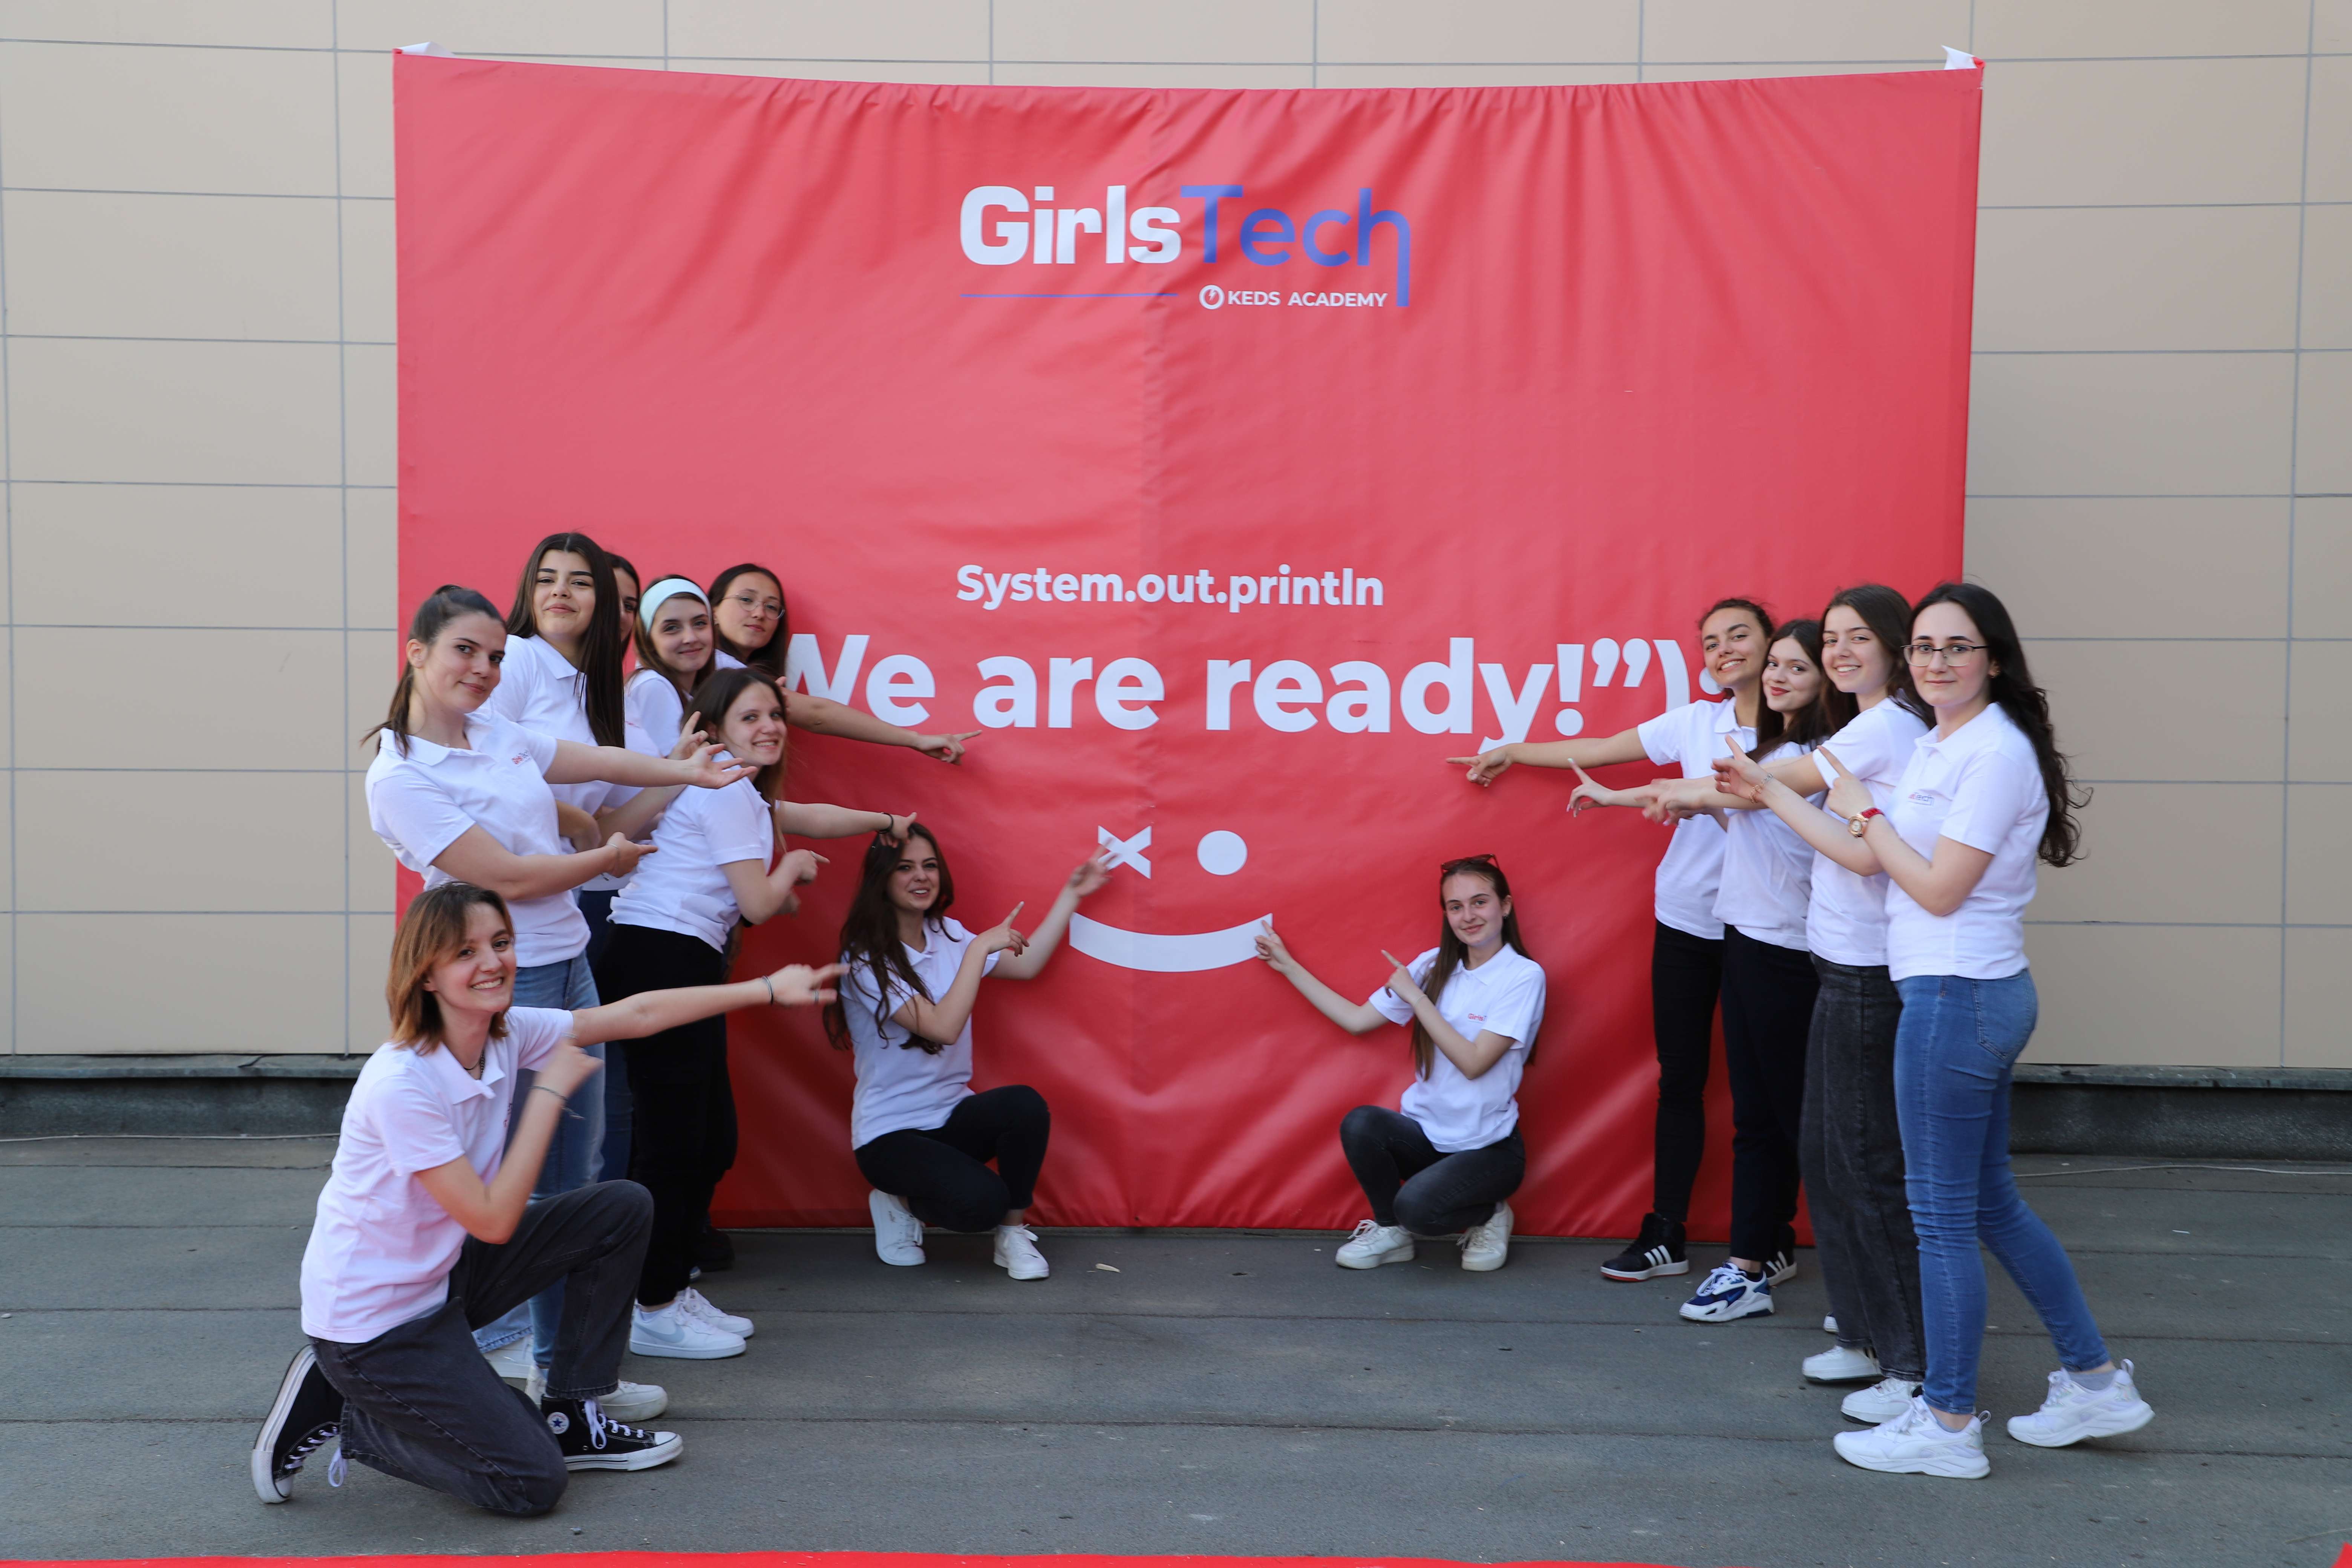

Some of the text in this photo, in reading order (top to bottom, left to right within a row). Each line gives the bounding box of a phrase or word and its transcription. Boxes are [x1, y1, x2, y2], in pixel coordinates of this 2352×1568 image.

[960, 185, 1411, 307] GirlsTech
[1228, 290, 1387, 307] KEDS ACADEMY
[956, 564, 1383, 613] System.out.println
[973, 655, 1164, 730] are
